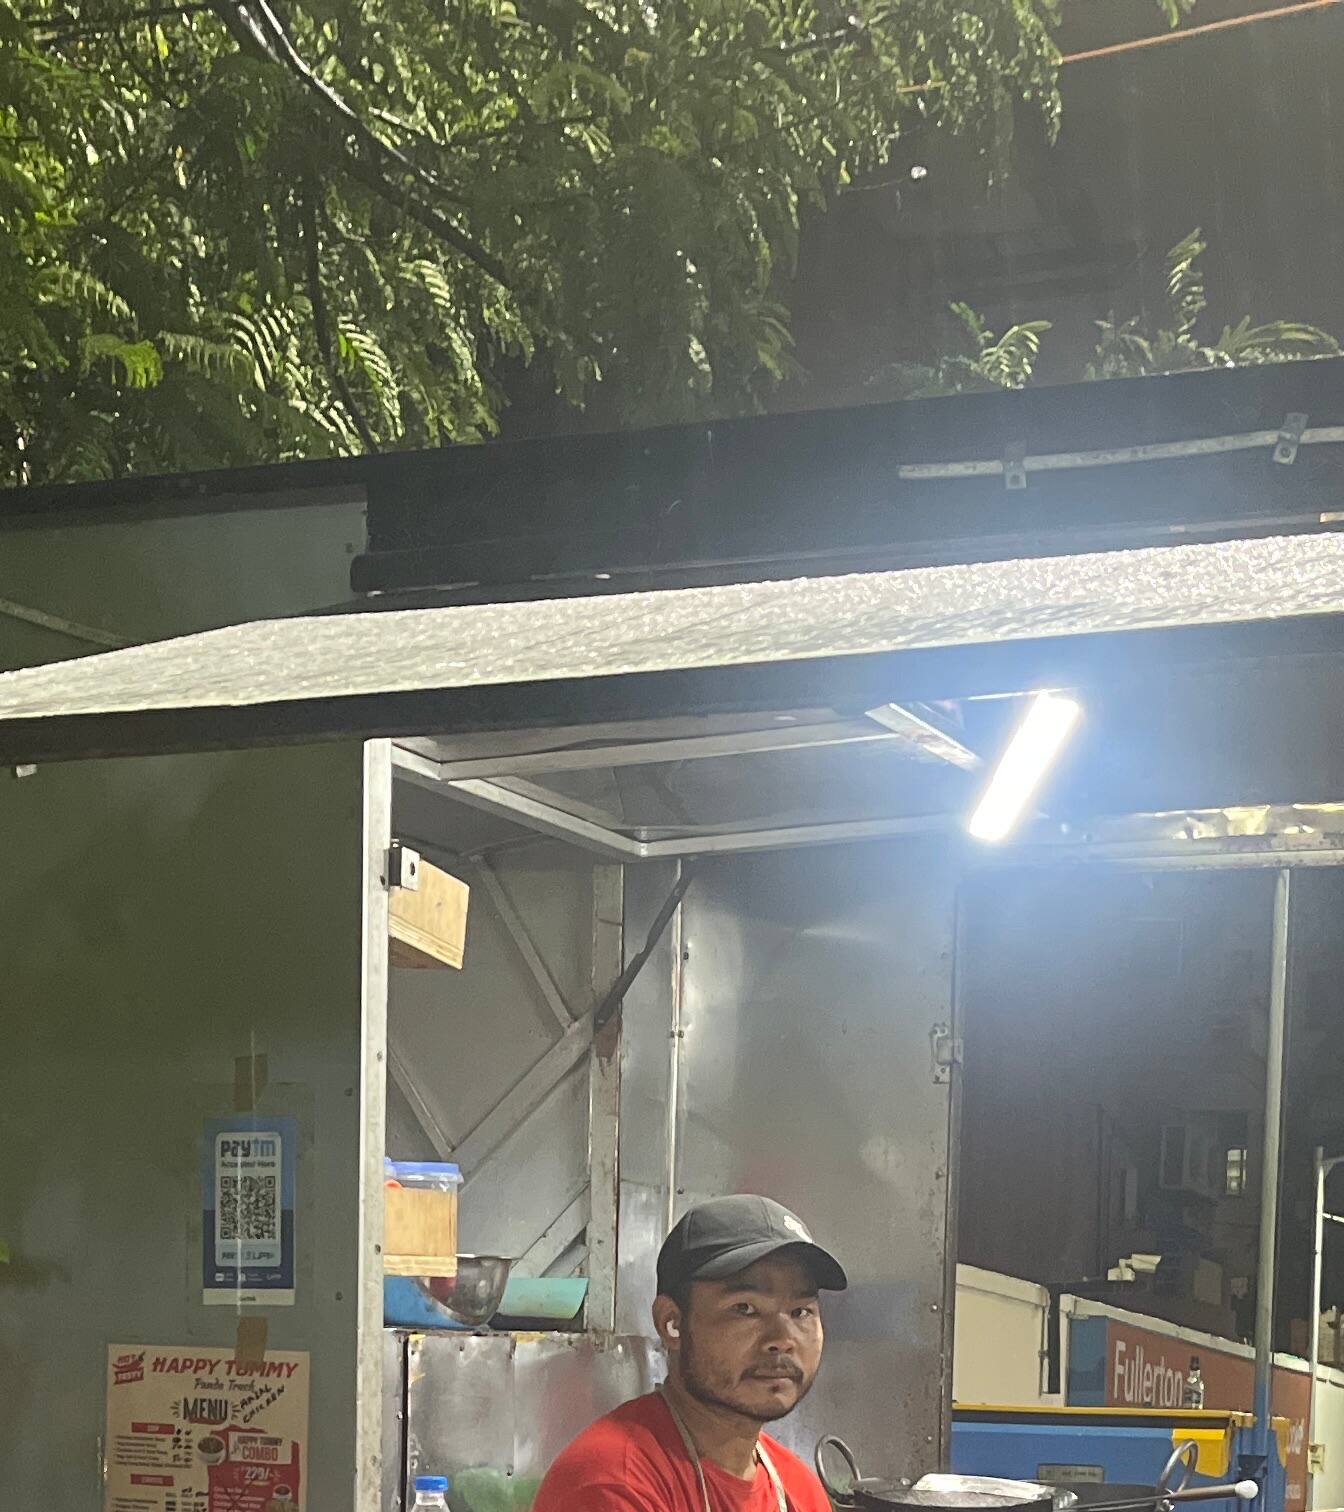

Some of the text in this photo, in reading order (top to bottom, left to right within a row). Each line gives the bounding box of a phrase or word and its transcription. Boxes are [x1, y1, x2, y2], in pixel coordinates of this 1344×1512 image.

[221, 1137, 276, 1157] paytm
[152, 1356, 300, 1379] HAPPY TUMMY
[1113, 1339, 1184, 1407] Fullerton
[183, 1396, 229, 1421] MENU
[242, 1445, 279, 1461] COMBO
